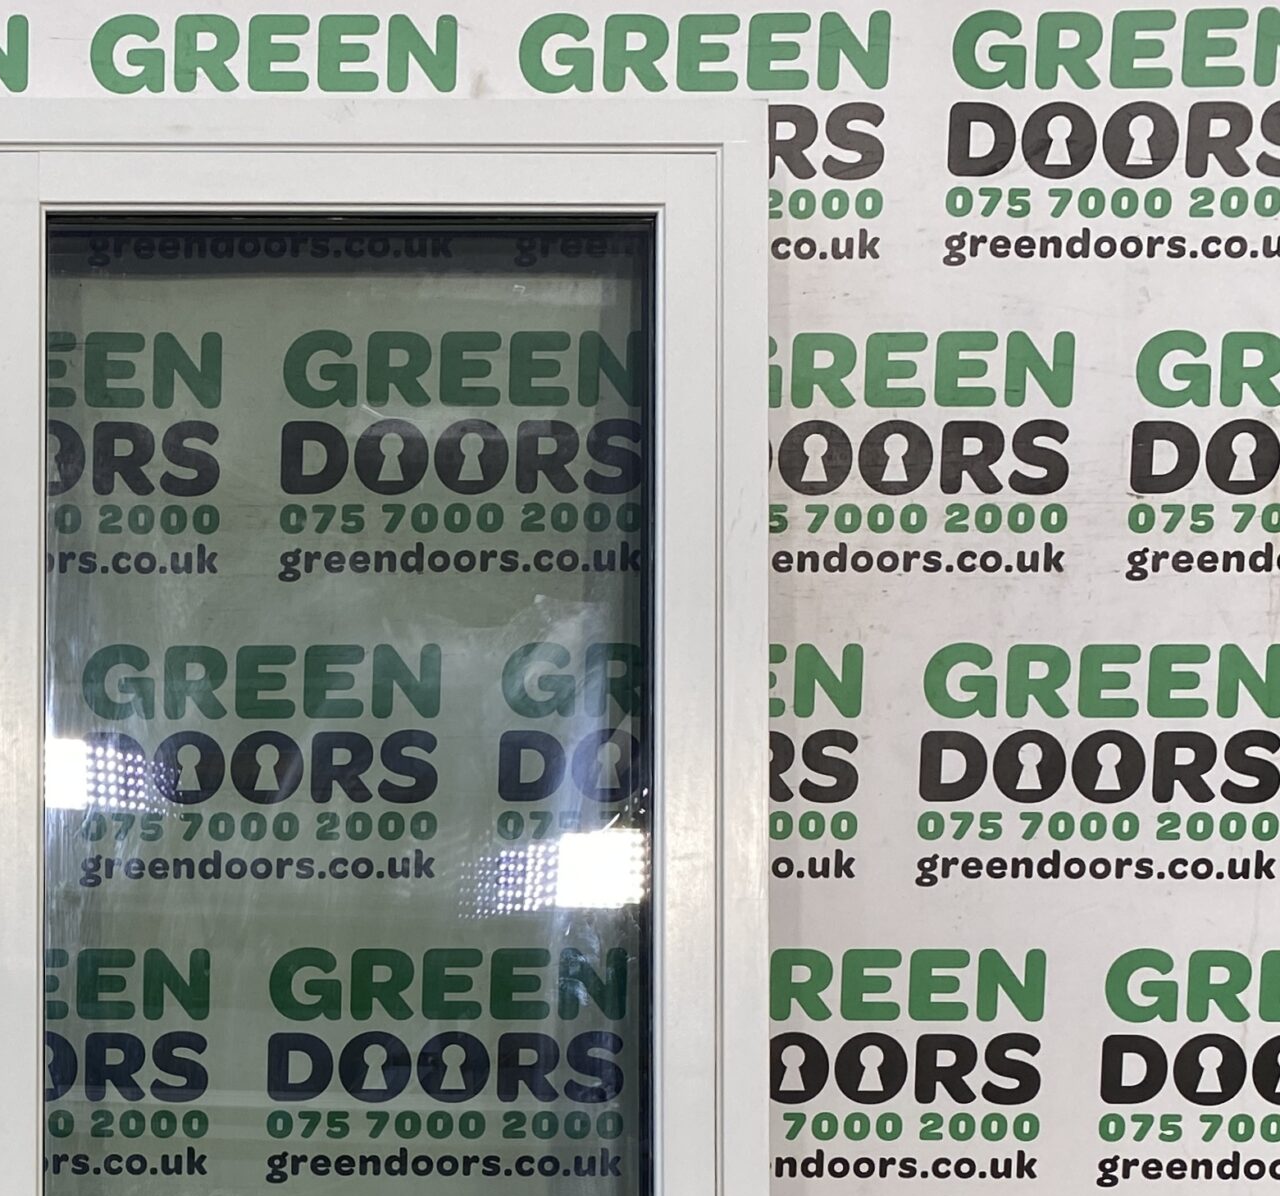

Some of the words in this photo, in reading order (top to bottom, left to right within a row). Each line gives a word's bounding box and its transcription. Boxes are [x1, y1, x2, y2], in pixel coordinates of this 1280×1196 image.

[90, 14, 457, 94] GREEN
[519, 10, 891, 93] GREEN
[946, 187, 1030, 218] 075
[1049, 188, 1172, 218] 7000
[283, 330, 642, 408] GREEN
[769, 331, 1075, 408] REEN
[281, 419, 641, 496] DOORS
[99, 504, 220, 535] 2000
[280, 504, 365, 534] 075
[382, 503, 504, 533] 7000
[521, 502, 641, 533] 2000
[805, 503, 927, 534] 7000
[945, 503, 1068, 534] 2000
[1128, 503, 1214, 533] 075
[278, 542, 641, 582] greendoors.co.uk
[772, 542, 1065, 573] endoors.co.uk
[82, 644, 441, 719] GREEN
[924, 643, 1280, 718] GREEN
[919, 730, 1280, 804] DOORS
[182, 811, 299, 842] 7000
[316, 811, 438, 841] 2000
[917, 811, 1002, 840] 075
[1020, 812, 1139, 841] 7000
[1156, 812, 1279, 841] 2000
[78, 849, 435, 887] greendoors.co.uk
[915, 849, 1276, 887] greendoors.co.uk
[269, 947, 626, 1020] GREEN
[769, 949, 1046, 1022] REEN
[267, 1030, 623, 1104] DOORS
[91, 1109, 209, 1139] 2000
[266, 1110, 350, 1139] 075
[366, 1111, 486, 1139] 7000
[502, 1110, 624, 1140] 2000
[783, 1112, 902, 1141] 7000
[919, 1112, 1040, 1141] 2000
[1099, 1113, 1182, 1142] 075
[266, 1148, 621, 1183] greendoors.co.uk
